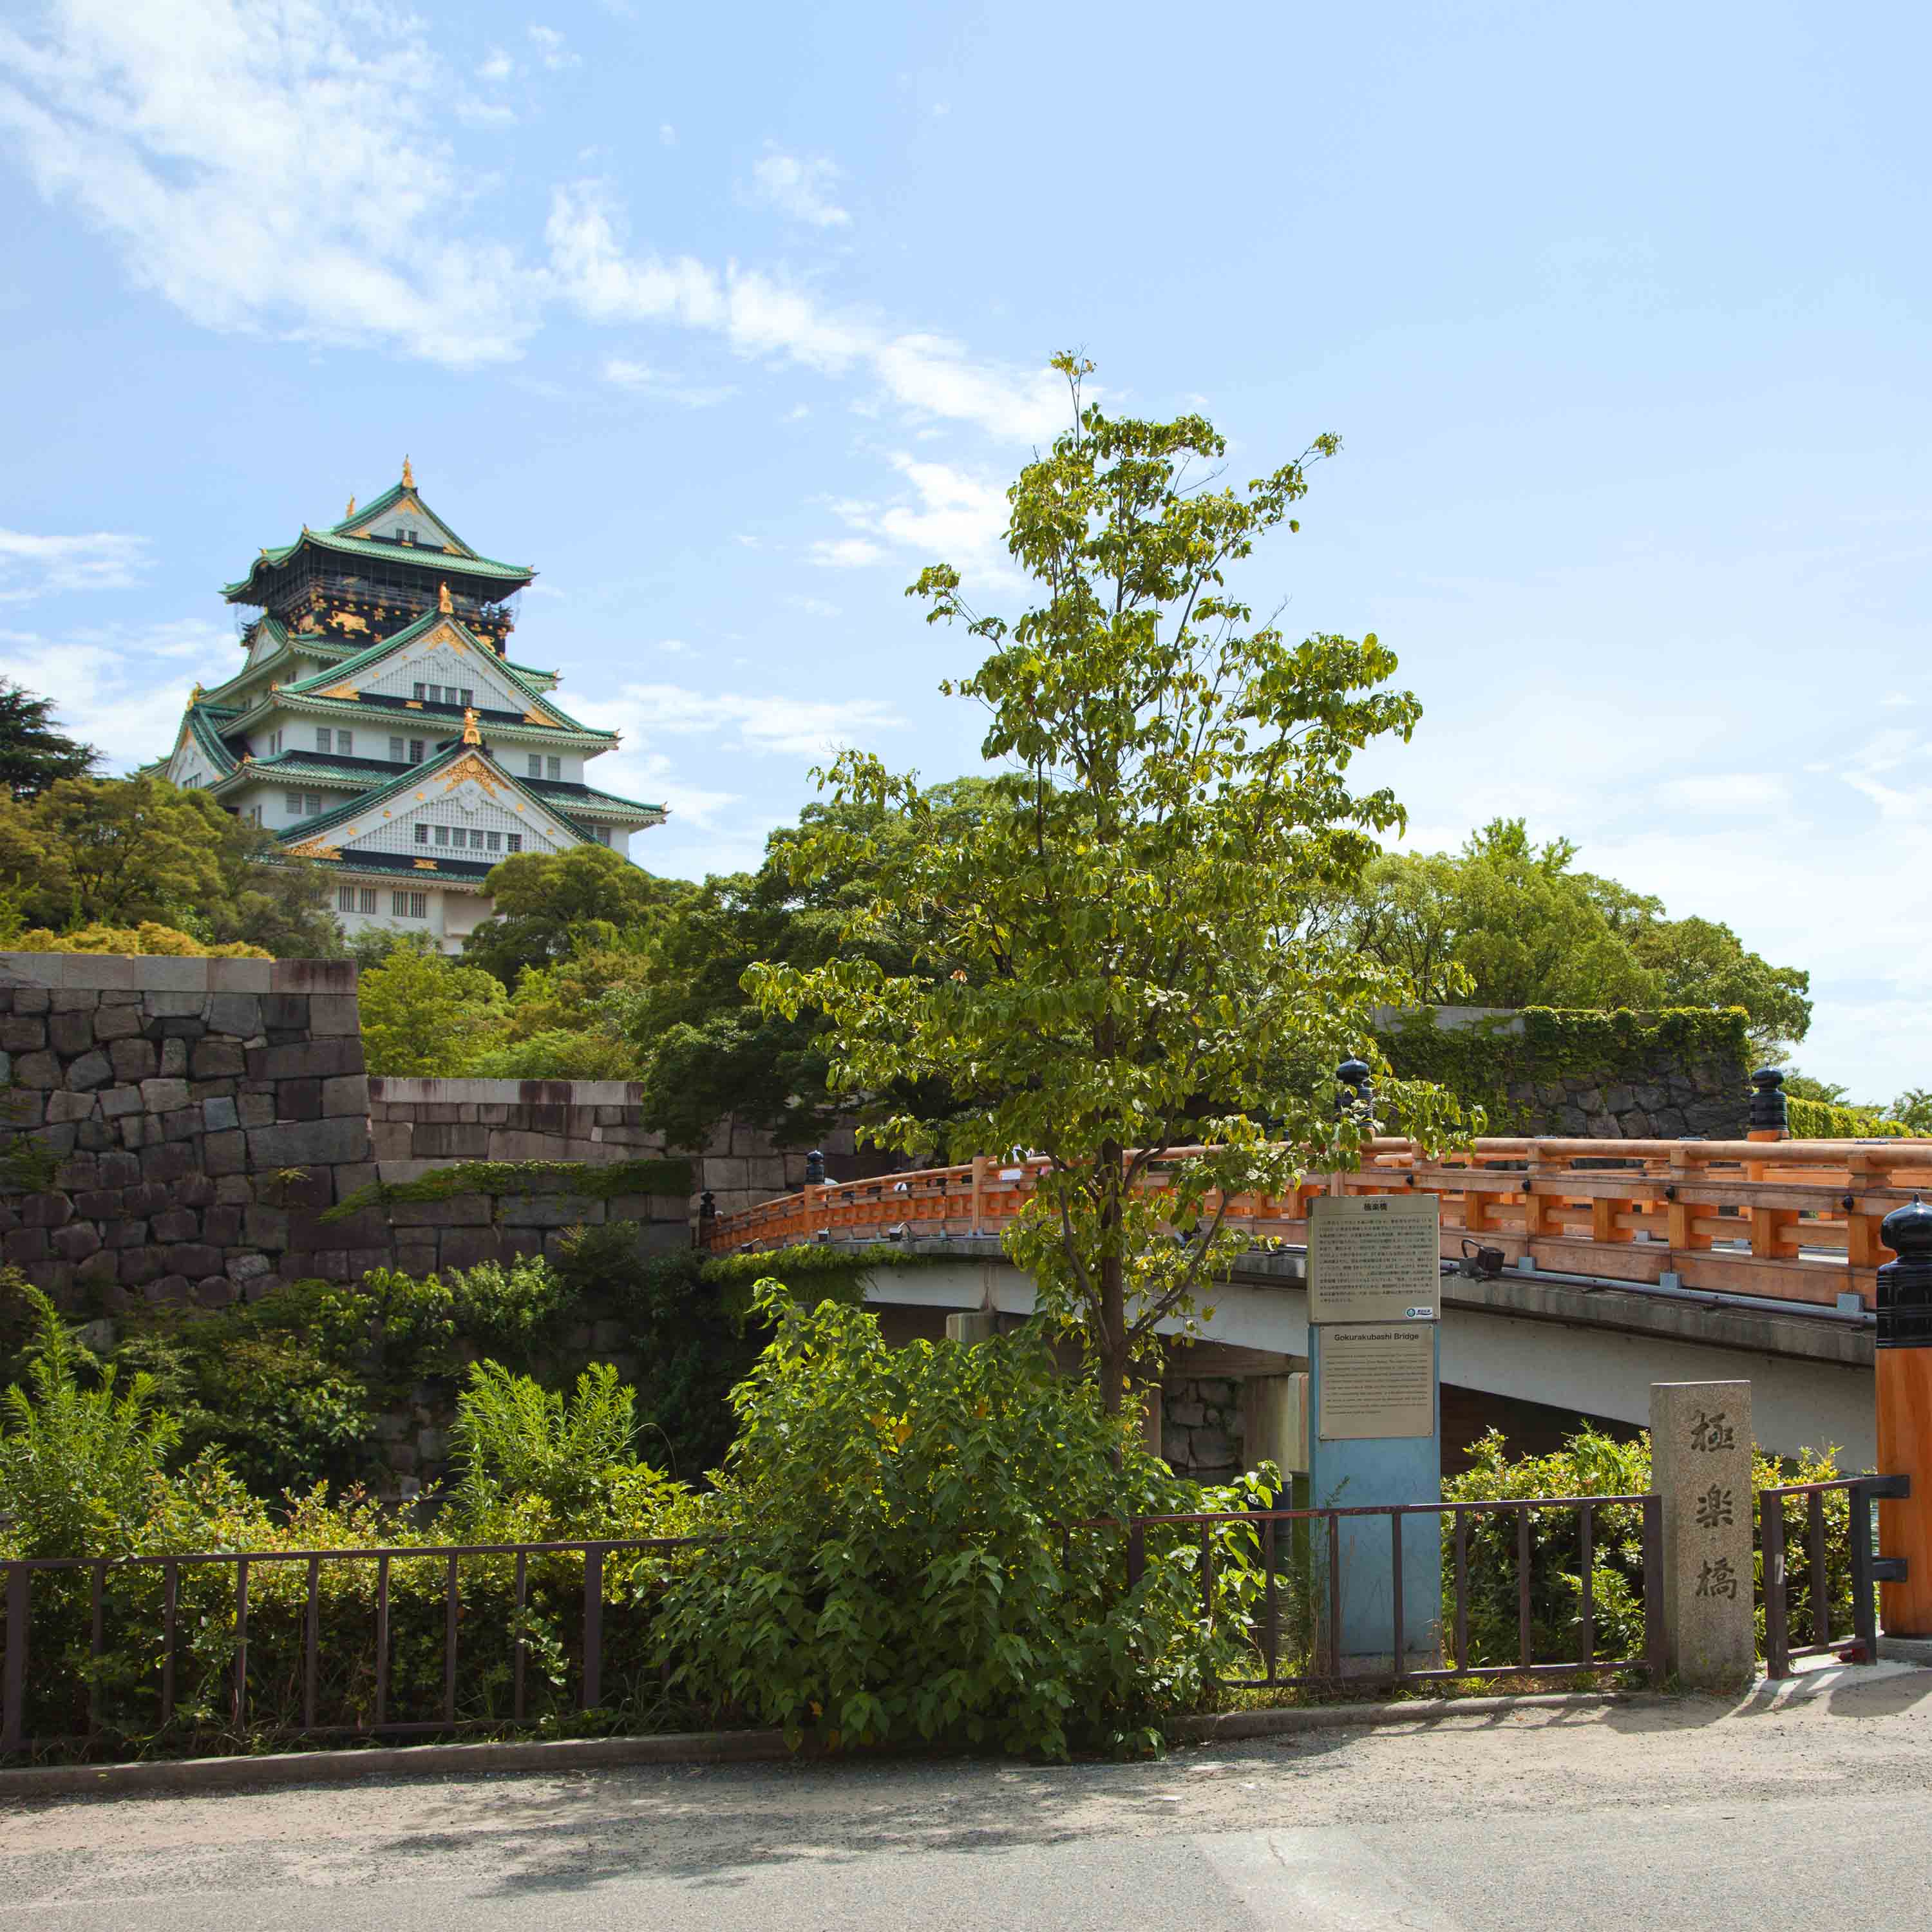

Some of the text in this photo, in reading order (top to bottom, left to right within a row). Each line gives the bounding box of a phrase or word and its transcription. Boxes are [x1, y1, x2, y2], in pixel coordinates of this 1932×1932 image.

[1334, 1332, 1419, 1341] Gokurakubashi Bridge
[1690, 1412, 1738, 1600] 極楽橋
